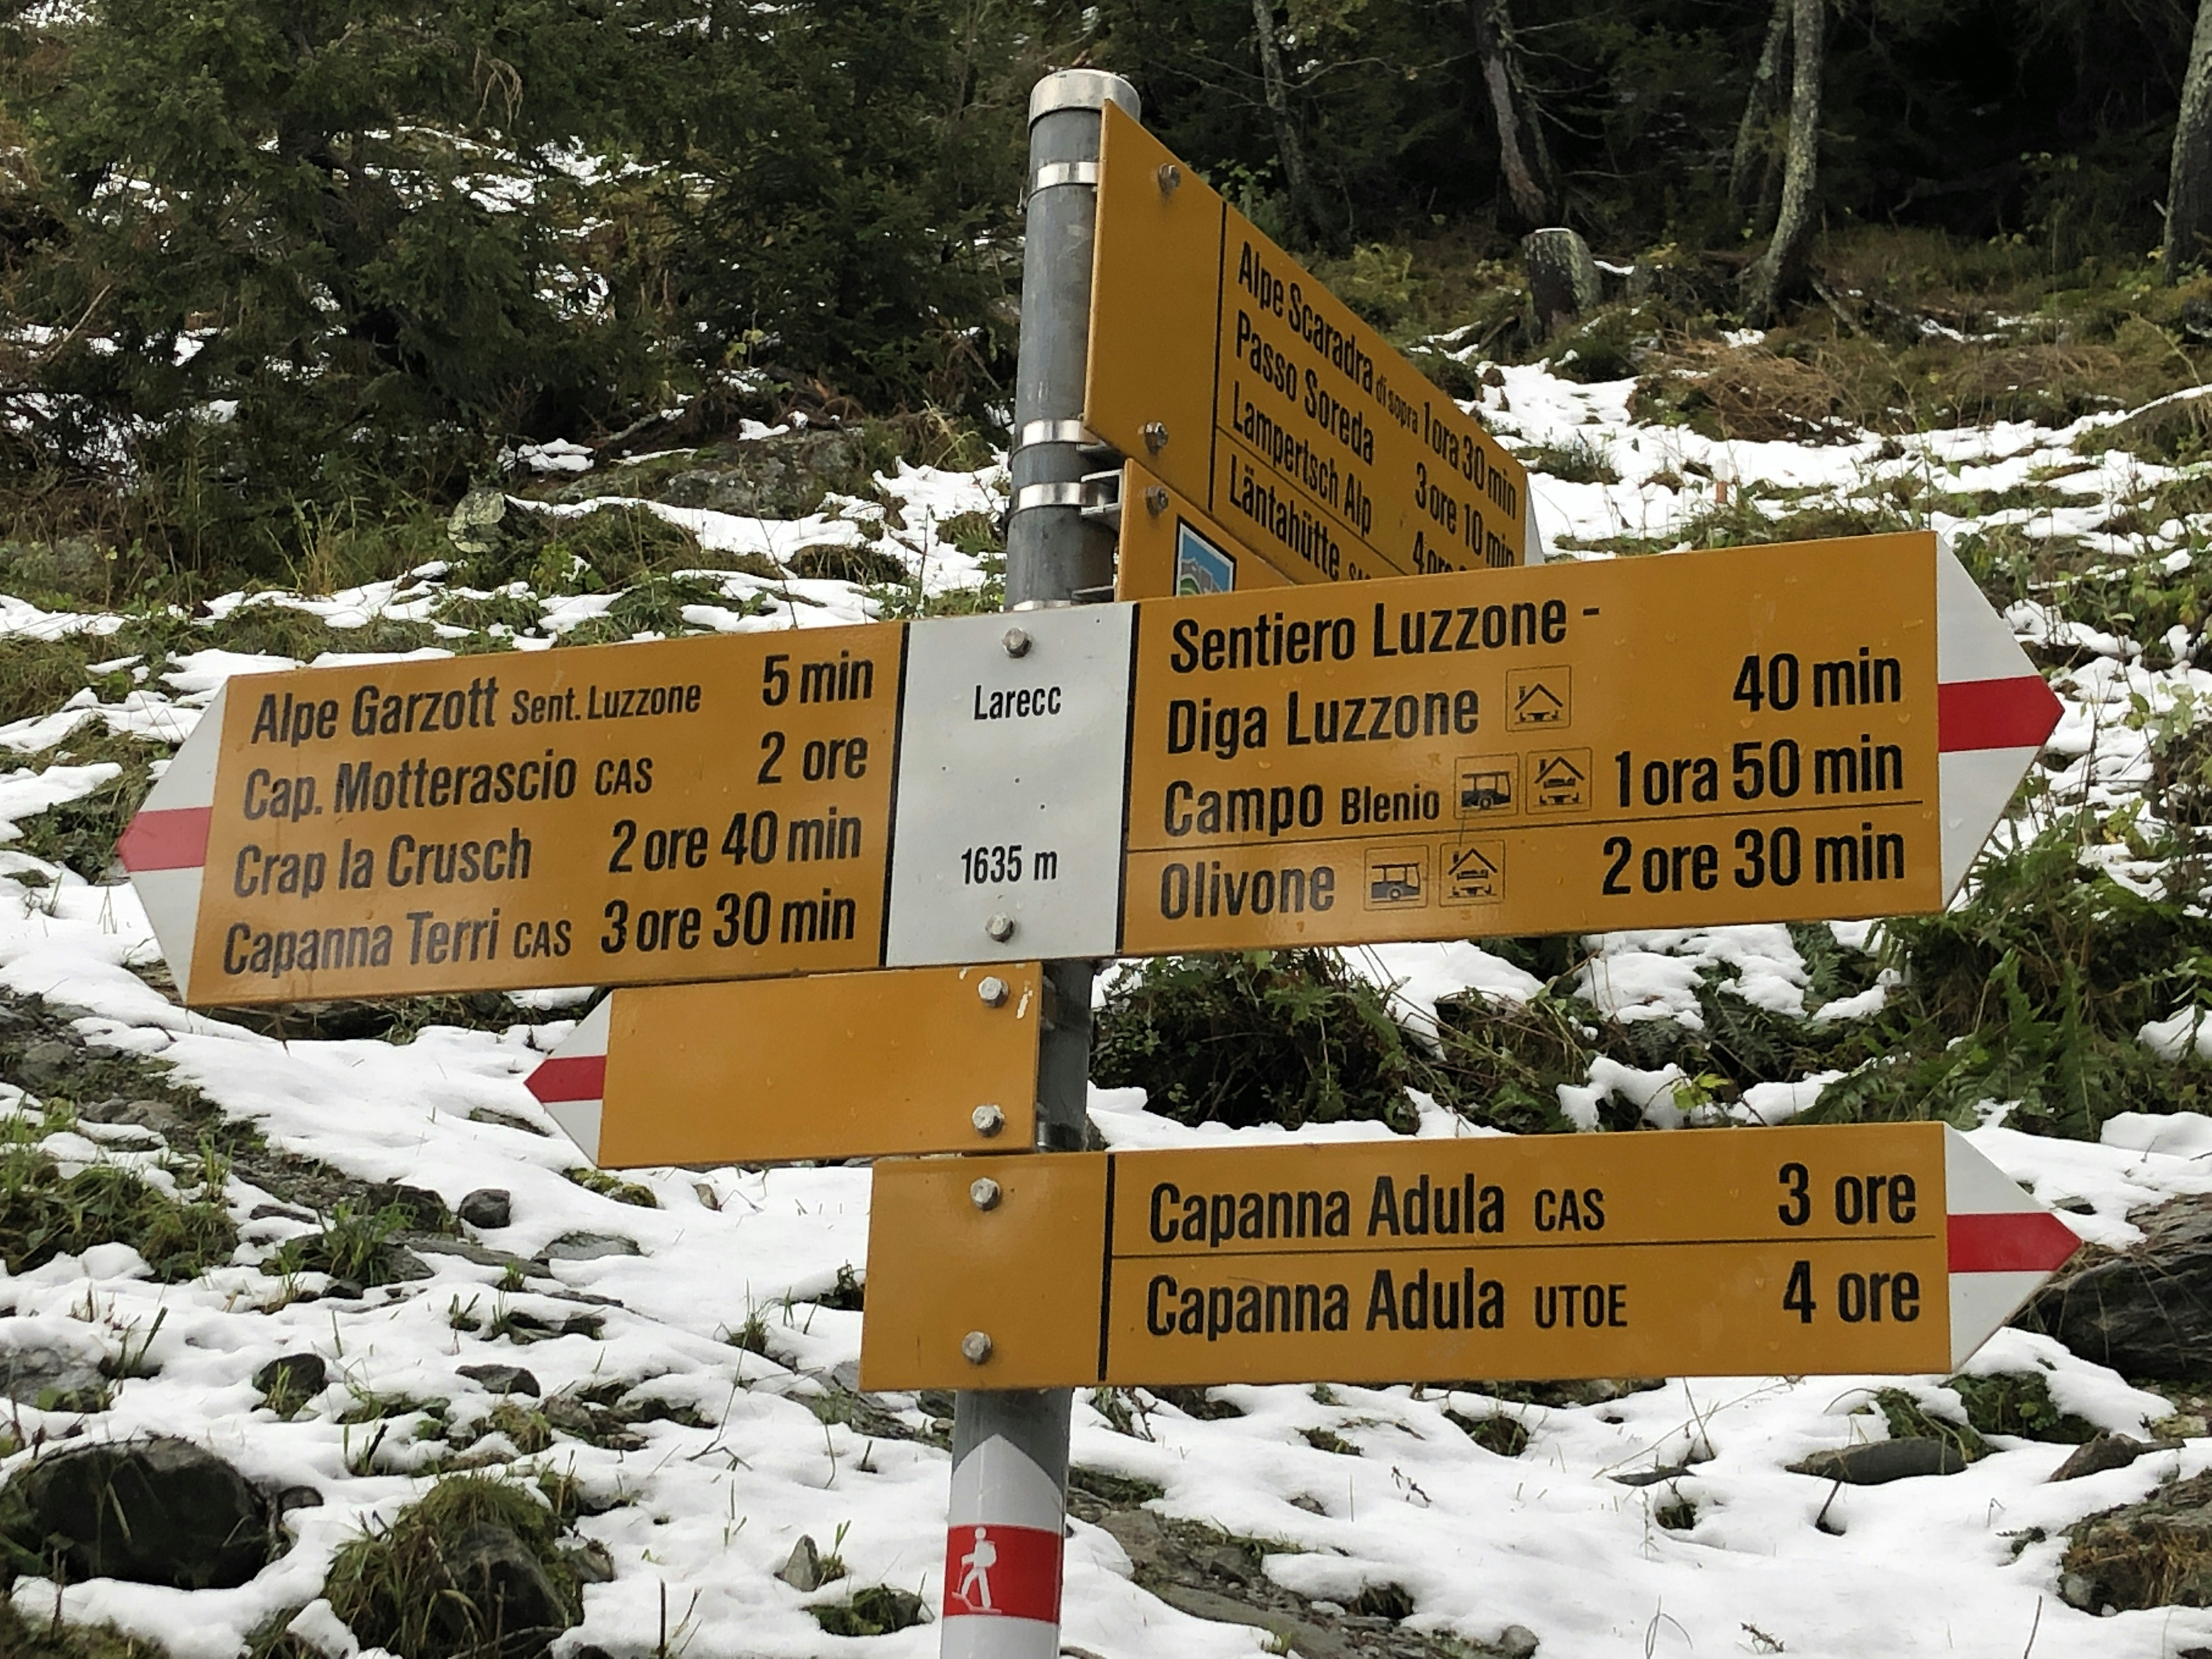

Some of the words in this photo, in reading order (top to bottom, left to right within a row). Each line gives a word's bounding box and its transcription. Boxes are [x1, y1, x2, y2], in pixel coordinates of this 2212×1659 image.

[1238, 241, 1284, 318] Alpe
[1289, 283, 1373, 395] Scaradra
[1376, 374, 1386, 407] di
[1388, 390, 1418, 435] sopra
[1463, 435, 1485, 491] 30
[1488, 465, 1516, 520] min
[1234, 381, 1338, 509] Lampertsch
[1344, 473, 1371, 538] Alp
[1237, 309, 1296, 402] Passo
[1305, 368, 1373, 466] Soreda
[1415, 462, 1426, 509] 3
[1430, 484, 1456, 534] ore
[1465, 504, 1482, 556] 10
[1230, 454, 1339, 581] Läntahütte
[1171, 612, 1355, 673] Sentiero
[1374, 600, 1566, 657] Luzzone
[251, 693, 338, 747] Alpe
[352, 677, 499, 736] Garzott
[512, 687, 580, 725] Sent.
[588, 685, 701, 719] Luzzone
[763, 654, 789, 706] 5
[800, 650, 873, 703] min
[974, 685, 1060, 720] Larecc
[1168, 698, 1267, 759] Diga
[1288, 690, 1478, 746] Luzzone
[1733, 653, 1799, 712] 40
[1813, 647, 1900, 707] min
[245, 769, 321, 822] Cap.
[334, 749, 577, 812] Motterascio
[595, 758, 652, 795] CAS
[758, 731, 785, 785] 2
[803, 737, 867, 781] ore
[1165, 781, 1323, 837] Campo
[1341, 784, 1439, 825] Blenio
[1615, 751, 1630, 808] 1
[1643, 758, 1718, 805] ora
[1733, 739, 1800, 800] 50
[1815, 734, 1903, 794] min
[235, 845, 325, 898] Crap
[339, 839, 373, 889] la
[388, 828, 531, 887] Crusch
[609, 820, 636, 873] 2
[644, 827, 708, 871] ore
[721, 810, 777, 865] 40
[788, 807, 861, 862] min
[961, 845, 1022, 884] 1635
[1034, 851, 1057, 880] m
[1161, 861, 1334, 919] Olivone
[1602, 837, 1632, 895] 2
[1643, 845, 1718, 893] ore
[1734, 827, 1801, 888] 30
[1816, 822, 1904, 883] min
[224, 923, 392, 978] Capanna
[407, 909, 500, 964] Terri
[514, 920, 571, 958] CAS
[601, 900, 628, 953] 3
[636, 908, 701, 951] ore
[713, 891, 771, 947] 30
[781, 888, 855, 944] min
[1150, 1183, 1350, 1248] Capanna
[1368, 1173, 1504, 1236] Adula
[1535, 1188, 1605, 1232] CAS
[1779, 1163, 1810, 1226] 3
[1836, 1175, 1916, 1225] ore
[1147, 1275, 1348, 1341] Capanna
[1366, 1267, 1504, 1331] Adula
[1535, 1284, 1627, 1329] UTOE
[1783, 1260, 1816, 1323] 4
[1838, 1272, 1920, 1323] ore
